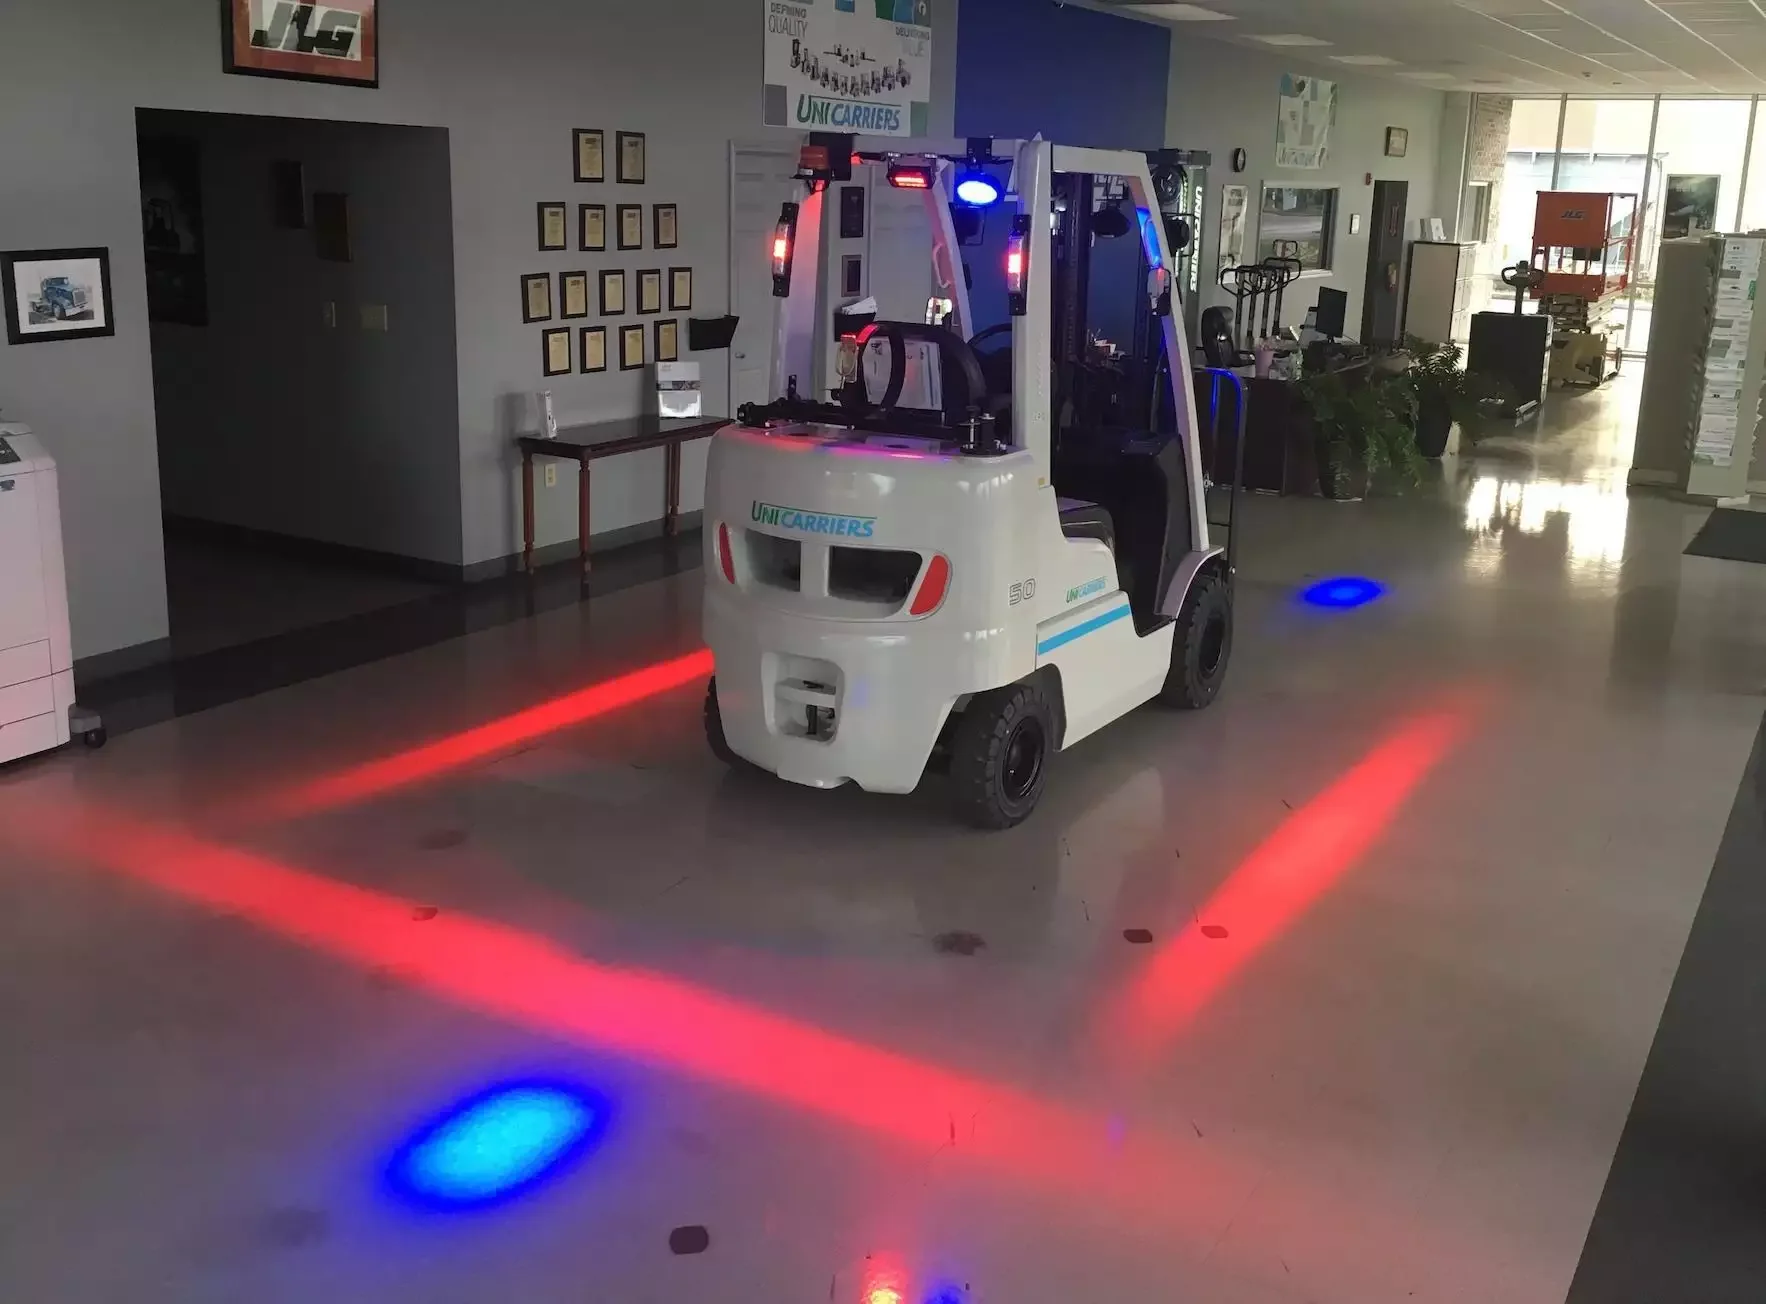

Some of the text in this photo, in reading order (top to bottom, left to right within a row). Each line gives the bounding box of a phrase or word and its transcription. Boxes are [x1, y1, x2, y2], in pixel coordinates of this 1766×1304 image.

[770, 2, 807, 18] DEFINING
[768, 14, 808, 38] QUALITY
[796, 94, 901, 131] UNICARRIERS
[751, 500, 876, 537] UNICARRIERS
[1009, 578, 1036, 606] 50
